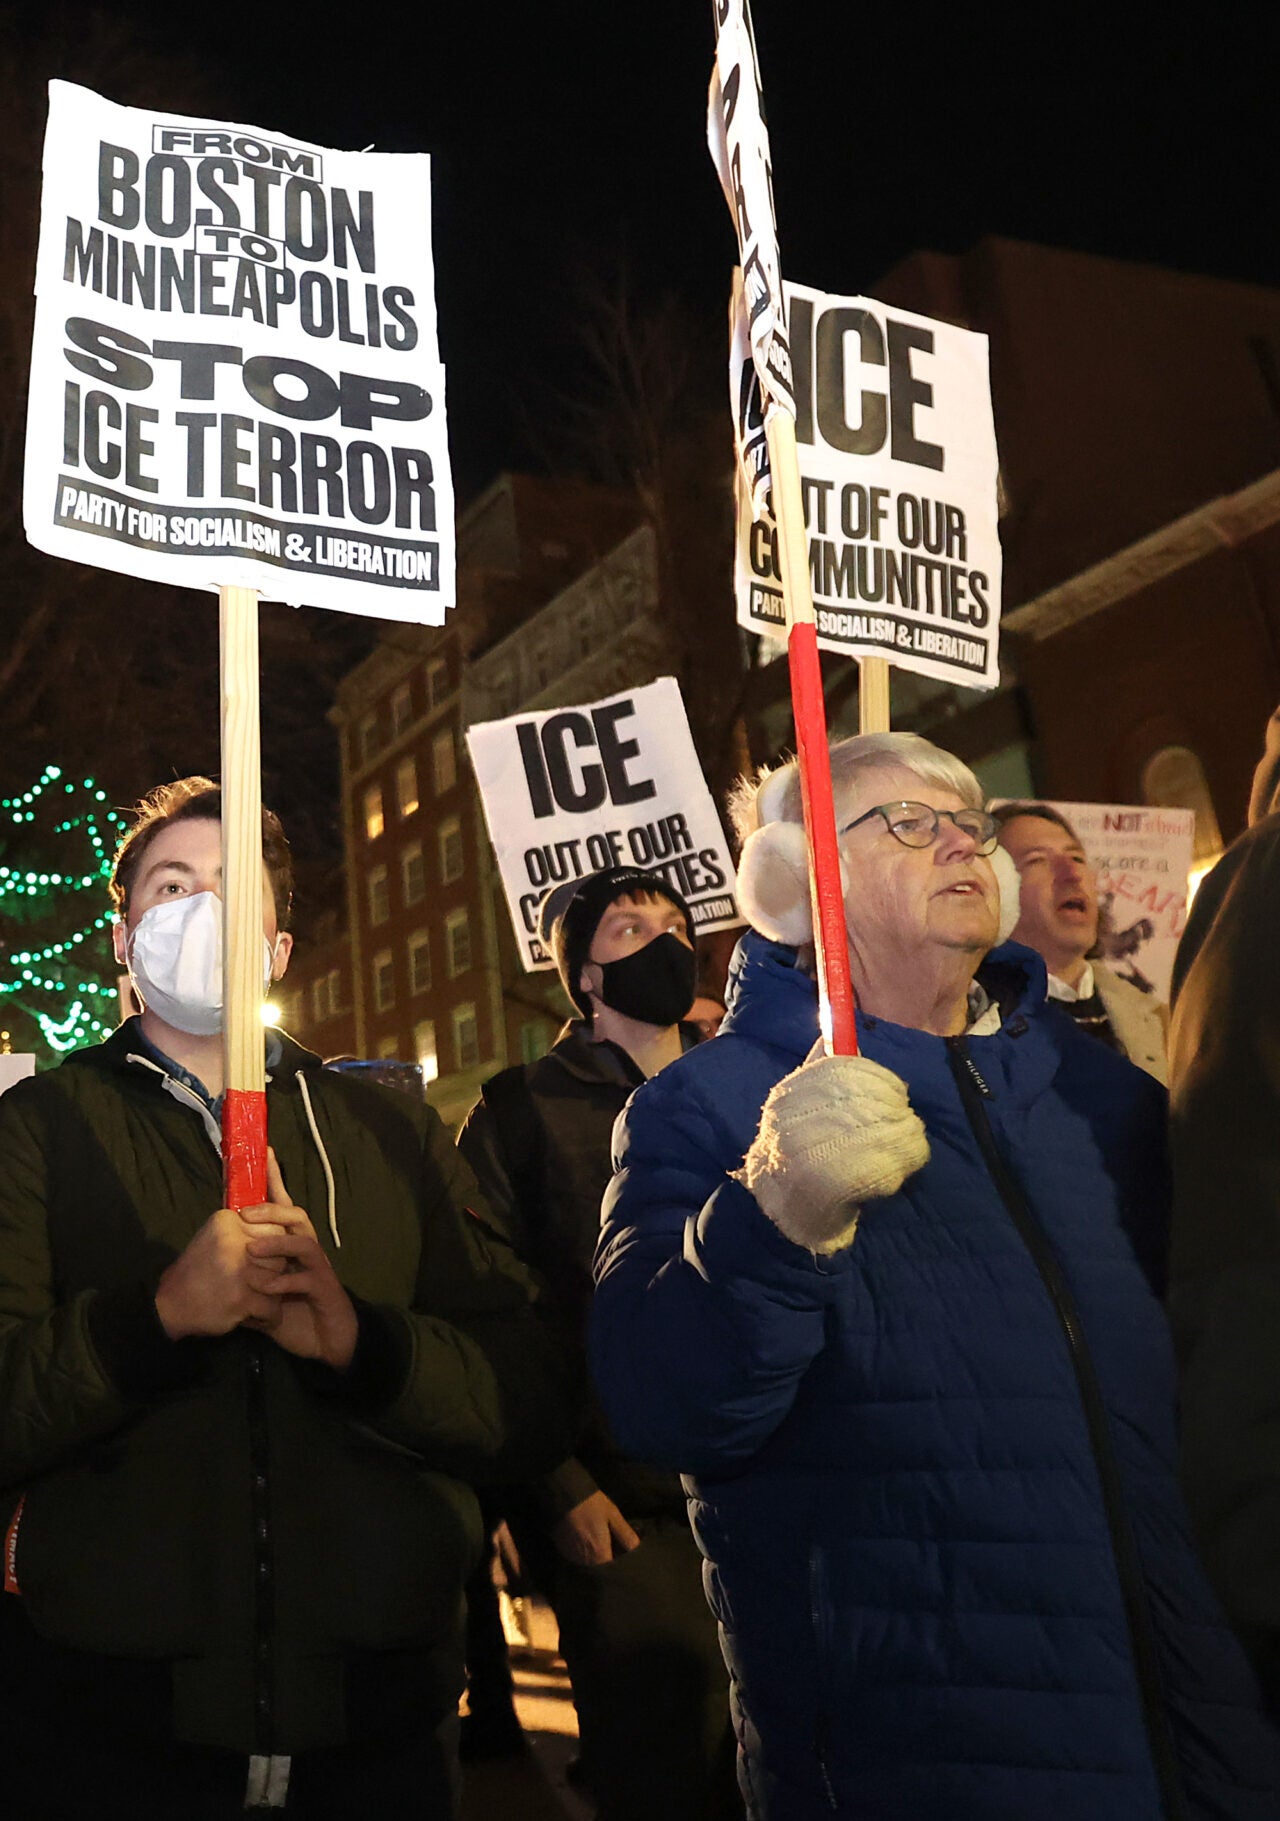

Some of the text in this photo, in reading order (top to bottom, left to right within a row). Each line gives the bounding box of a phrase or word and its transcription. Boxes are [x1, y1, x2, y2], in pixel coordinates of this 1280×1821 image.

[97, 139, 376, 274] BOSTON
[160, 129, 315, 178] FROM
[63, 215, 419, 352] MINNEAPOLIS
[203, 227, 278, 263] TO
[63, 315, 434, 432] STOP
[789, 296, 945, 473] ICE
[62, 379, 438, 533] ICE TERROR
[60, 486, 432, 583] PARTY FOR SOCIALISM & LIBERATION
[840, 481, 892, 541] OF
[896, 491, 969, 563] OUR
[753, 588, 786, 619] PART
[820, 612, 896, 645] SOCIALISM
[897, 626, 913, 648] &
[913, 627, 986, 668] LIBERATION
[516, 699, 658, 820] ICE
[524, 812, 694, 888] OUT OF OUR
